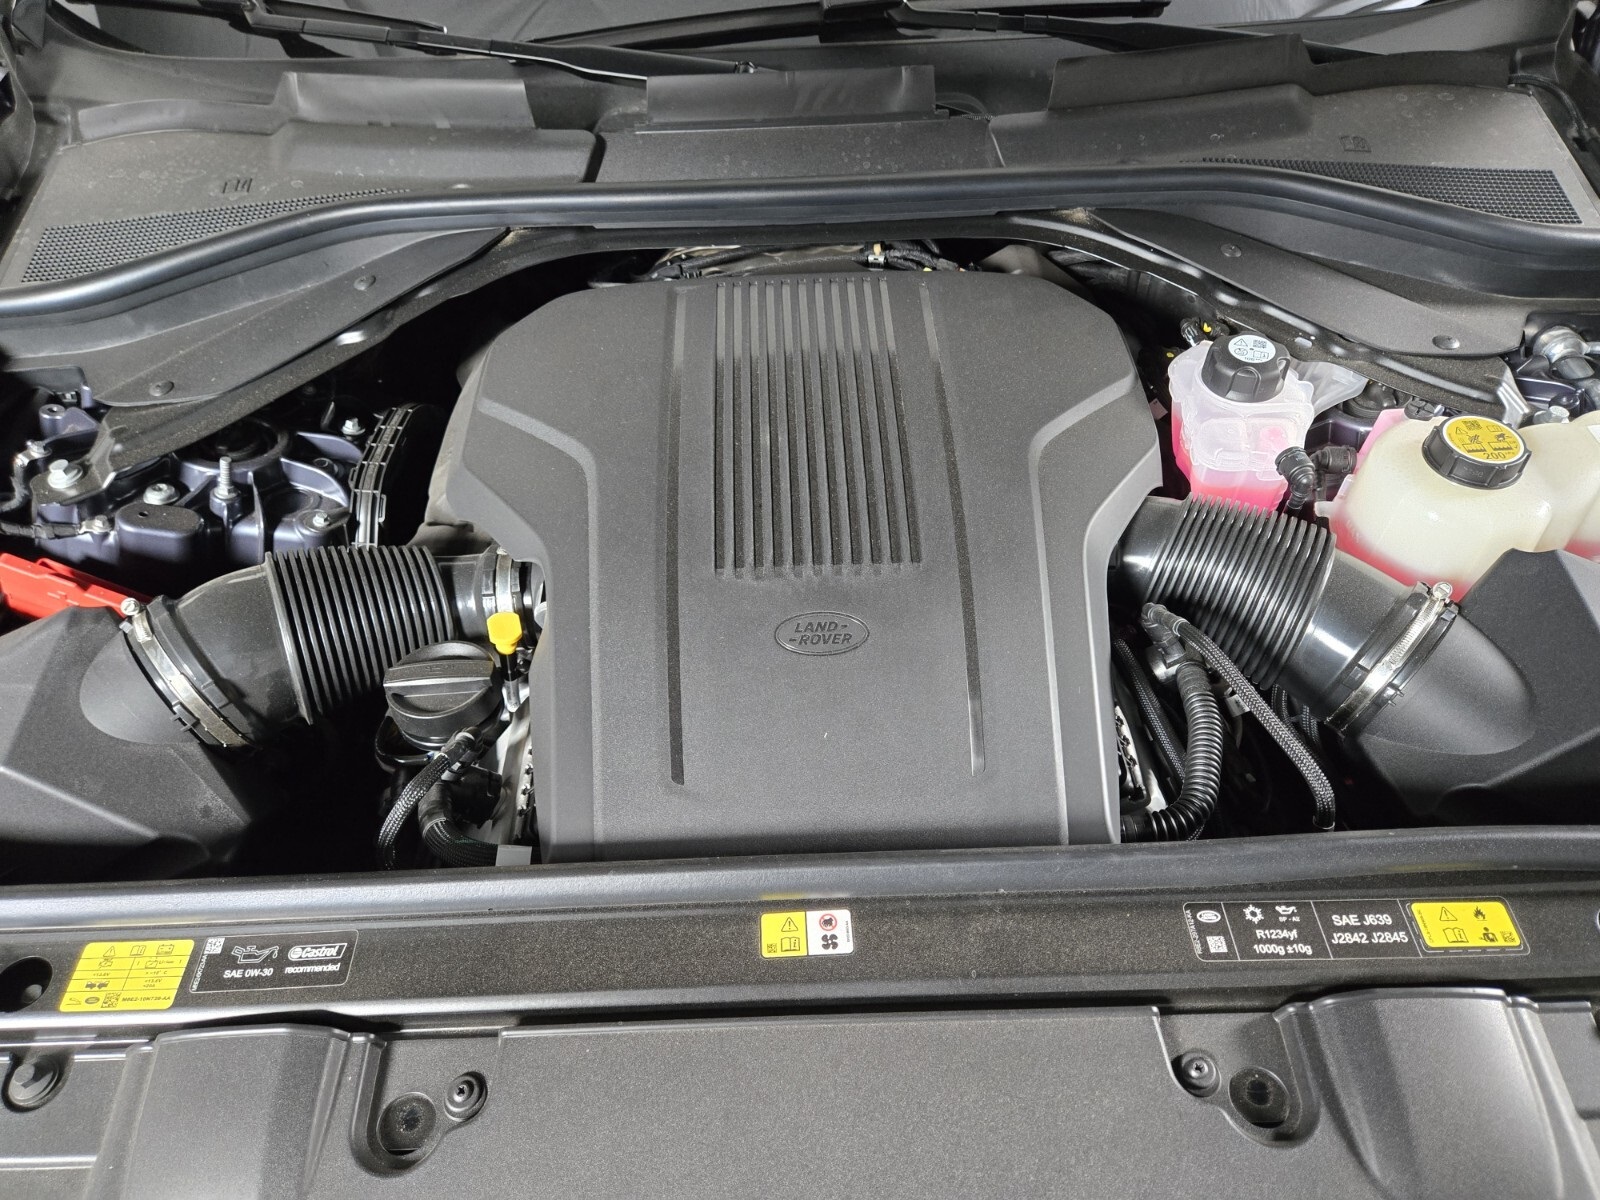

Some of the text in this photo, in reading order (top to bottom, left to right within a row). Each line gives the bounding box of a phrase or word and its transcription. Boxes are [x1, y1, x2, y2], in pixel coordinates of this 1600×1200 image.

[1483, 452, 1506, 460] 200
[1331, 913, 1393, 926] SAE J639
[1255, 929, 1298, 941] R1234yf
[1331, 931, 1409, 944] J2842 J2845
[301, 946, 339, 958] Castrol
[1253, 943, 1313, 956] 1000g ±10g
[223, 967, 274, 978] SAE 0W-30
[284, 962, 341, 974] recommended
